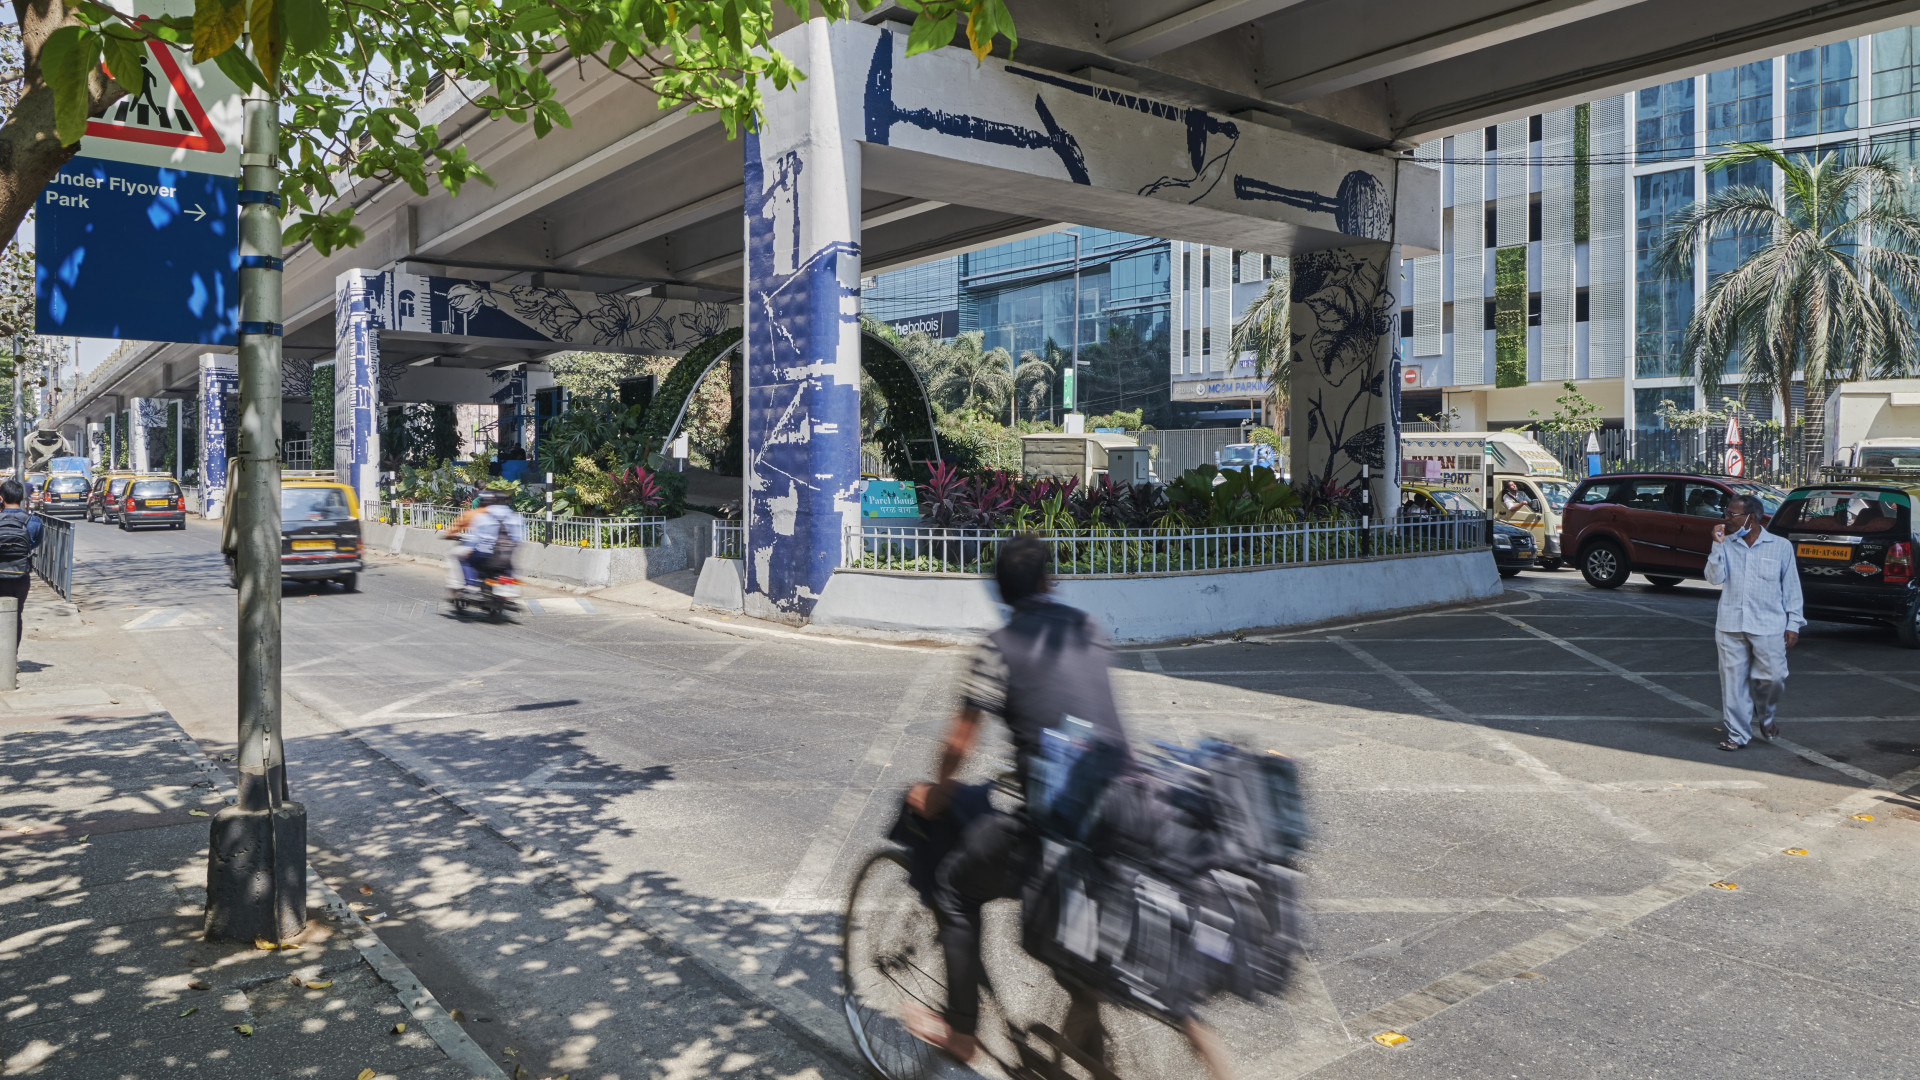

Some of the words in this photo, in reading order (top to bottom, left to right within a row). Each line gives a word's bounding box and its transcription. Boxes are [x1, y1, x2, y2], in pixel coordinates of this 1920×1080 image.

[109, 176, 177, 197] Flyover
[45, 190, 90, 209] Park
[869, 495, 891, 505] Parel
